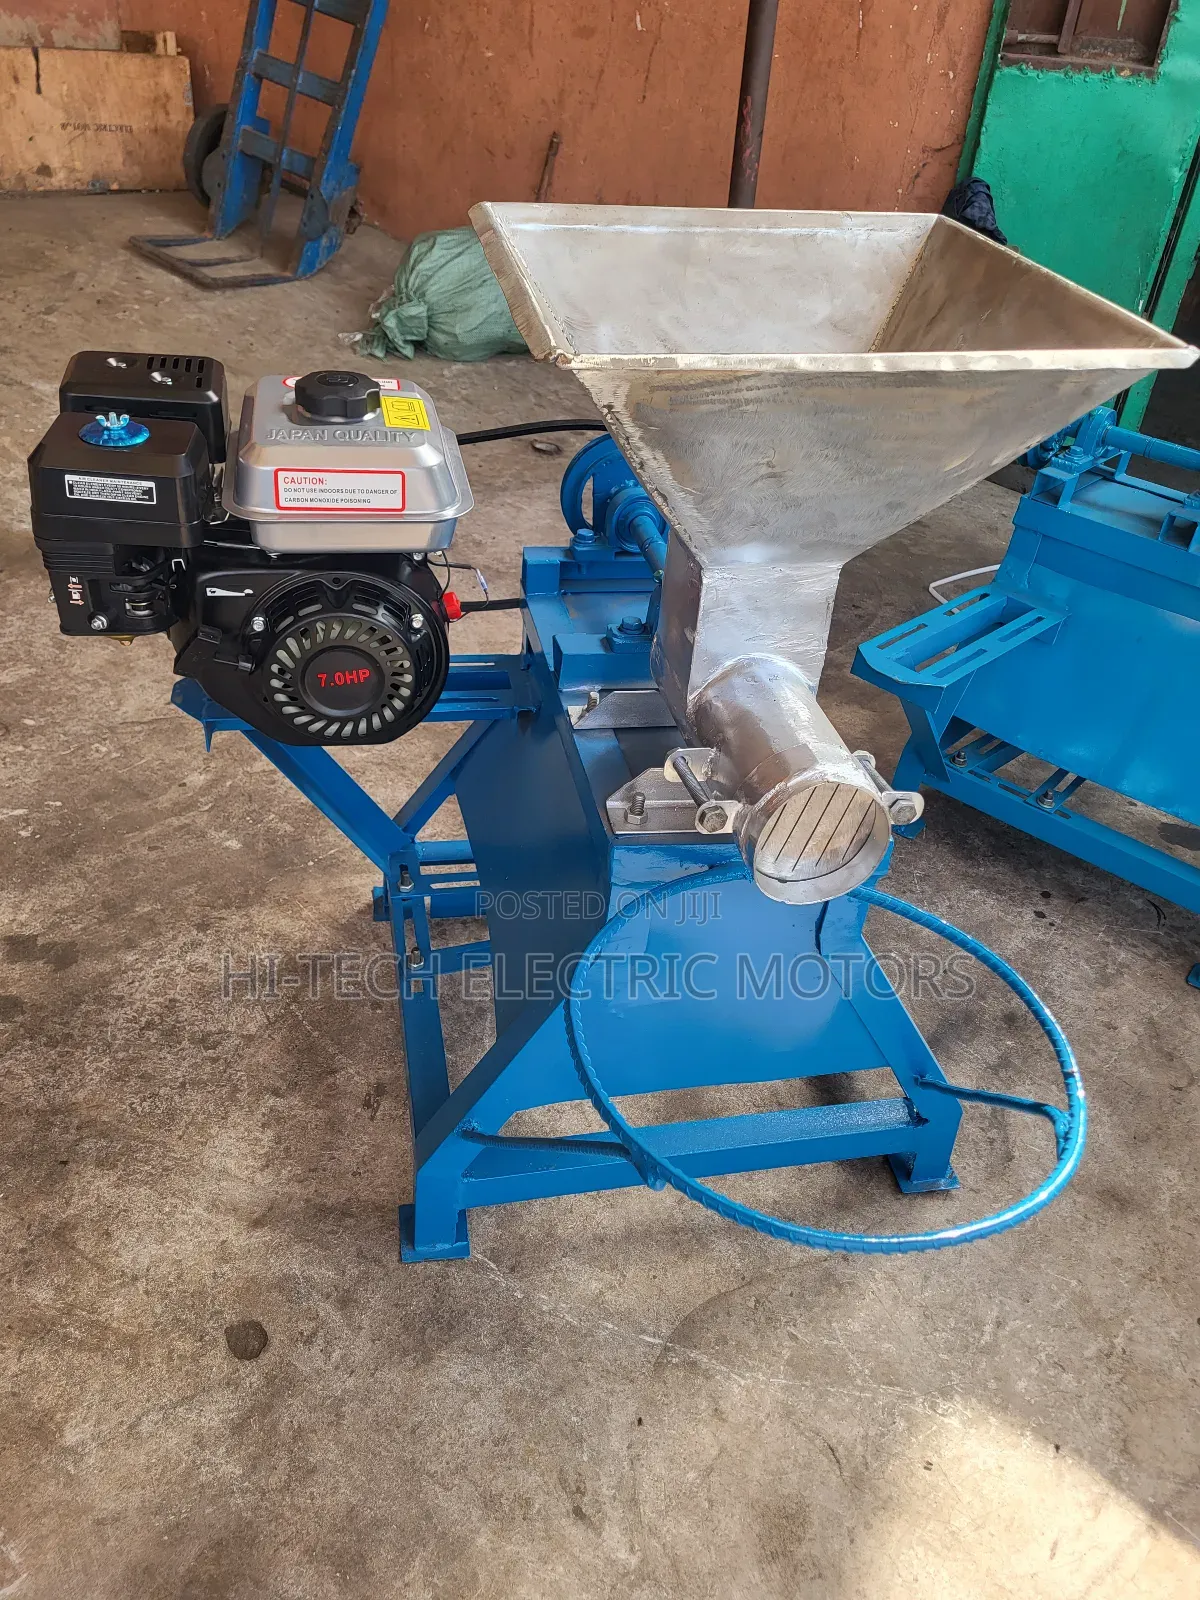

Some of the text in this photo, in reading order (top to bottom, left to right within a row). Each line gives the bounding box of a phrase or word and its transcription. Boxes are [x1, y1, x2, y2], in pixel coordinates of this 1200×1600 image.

[266, 428, 417, 442] JAPAN QUALITY
[283, 476, 328, 485] CAUTION:
[317, 668, 370, 688] 7.0HP
